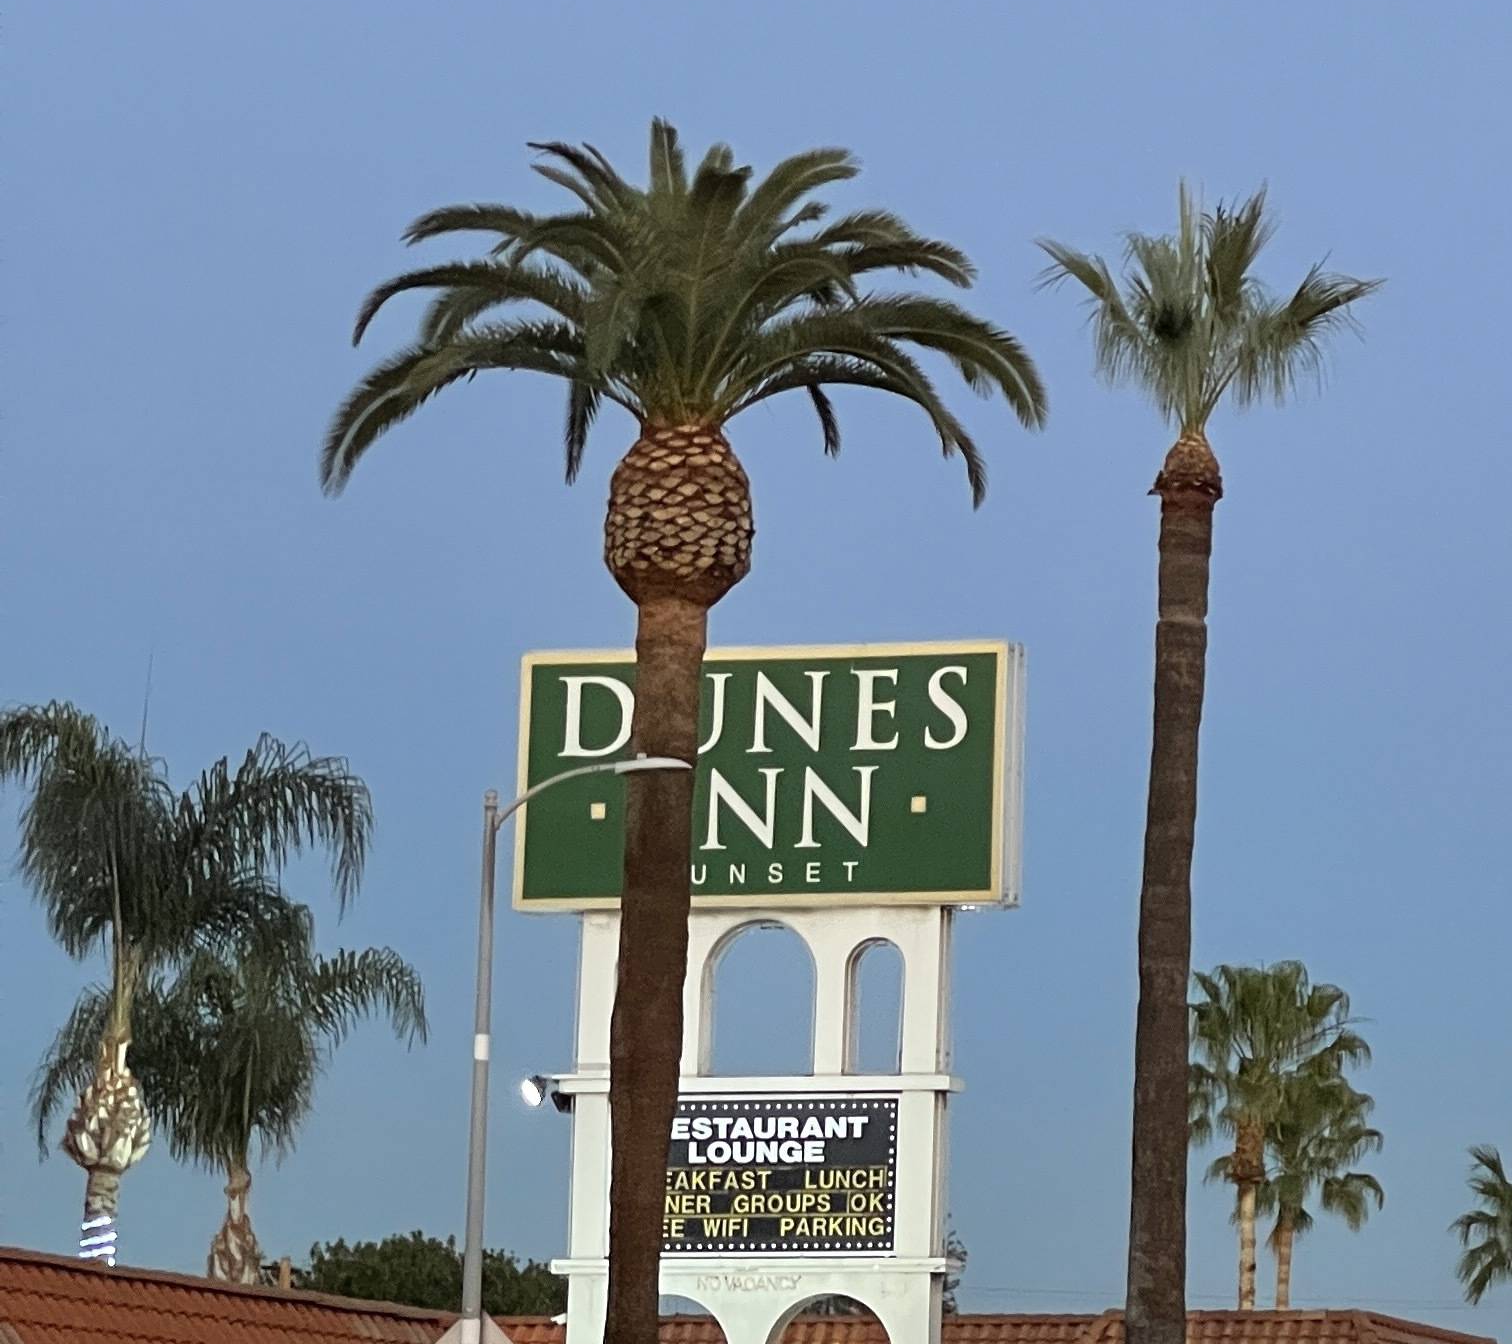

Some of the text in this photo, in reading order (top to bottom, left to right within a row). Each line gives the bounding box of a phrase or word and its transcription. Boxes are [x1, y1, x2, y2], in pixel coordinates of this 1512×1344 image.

[699, 765, 880, 851] NN
[691, 861, 860, 885] UNSET
[671, 1116, 869, 1140] ESTAURANT
[688, 1141, 826, 1163] LOUNGE
[666, 1169, 885, 1191] EAKFAST LUNCH
[665, 1193, 885, 1214] NER GROUPS OK
[663, 1218, 885, 1238] EE WIFI PARKING
